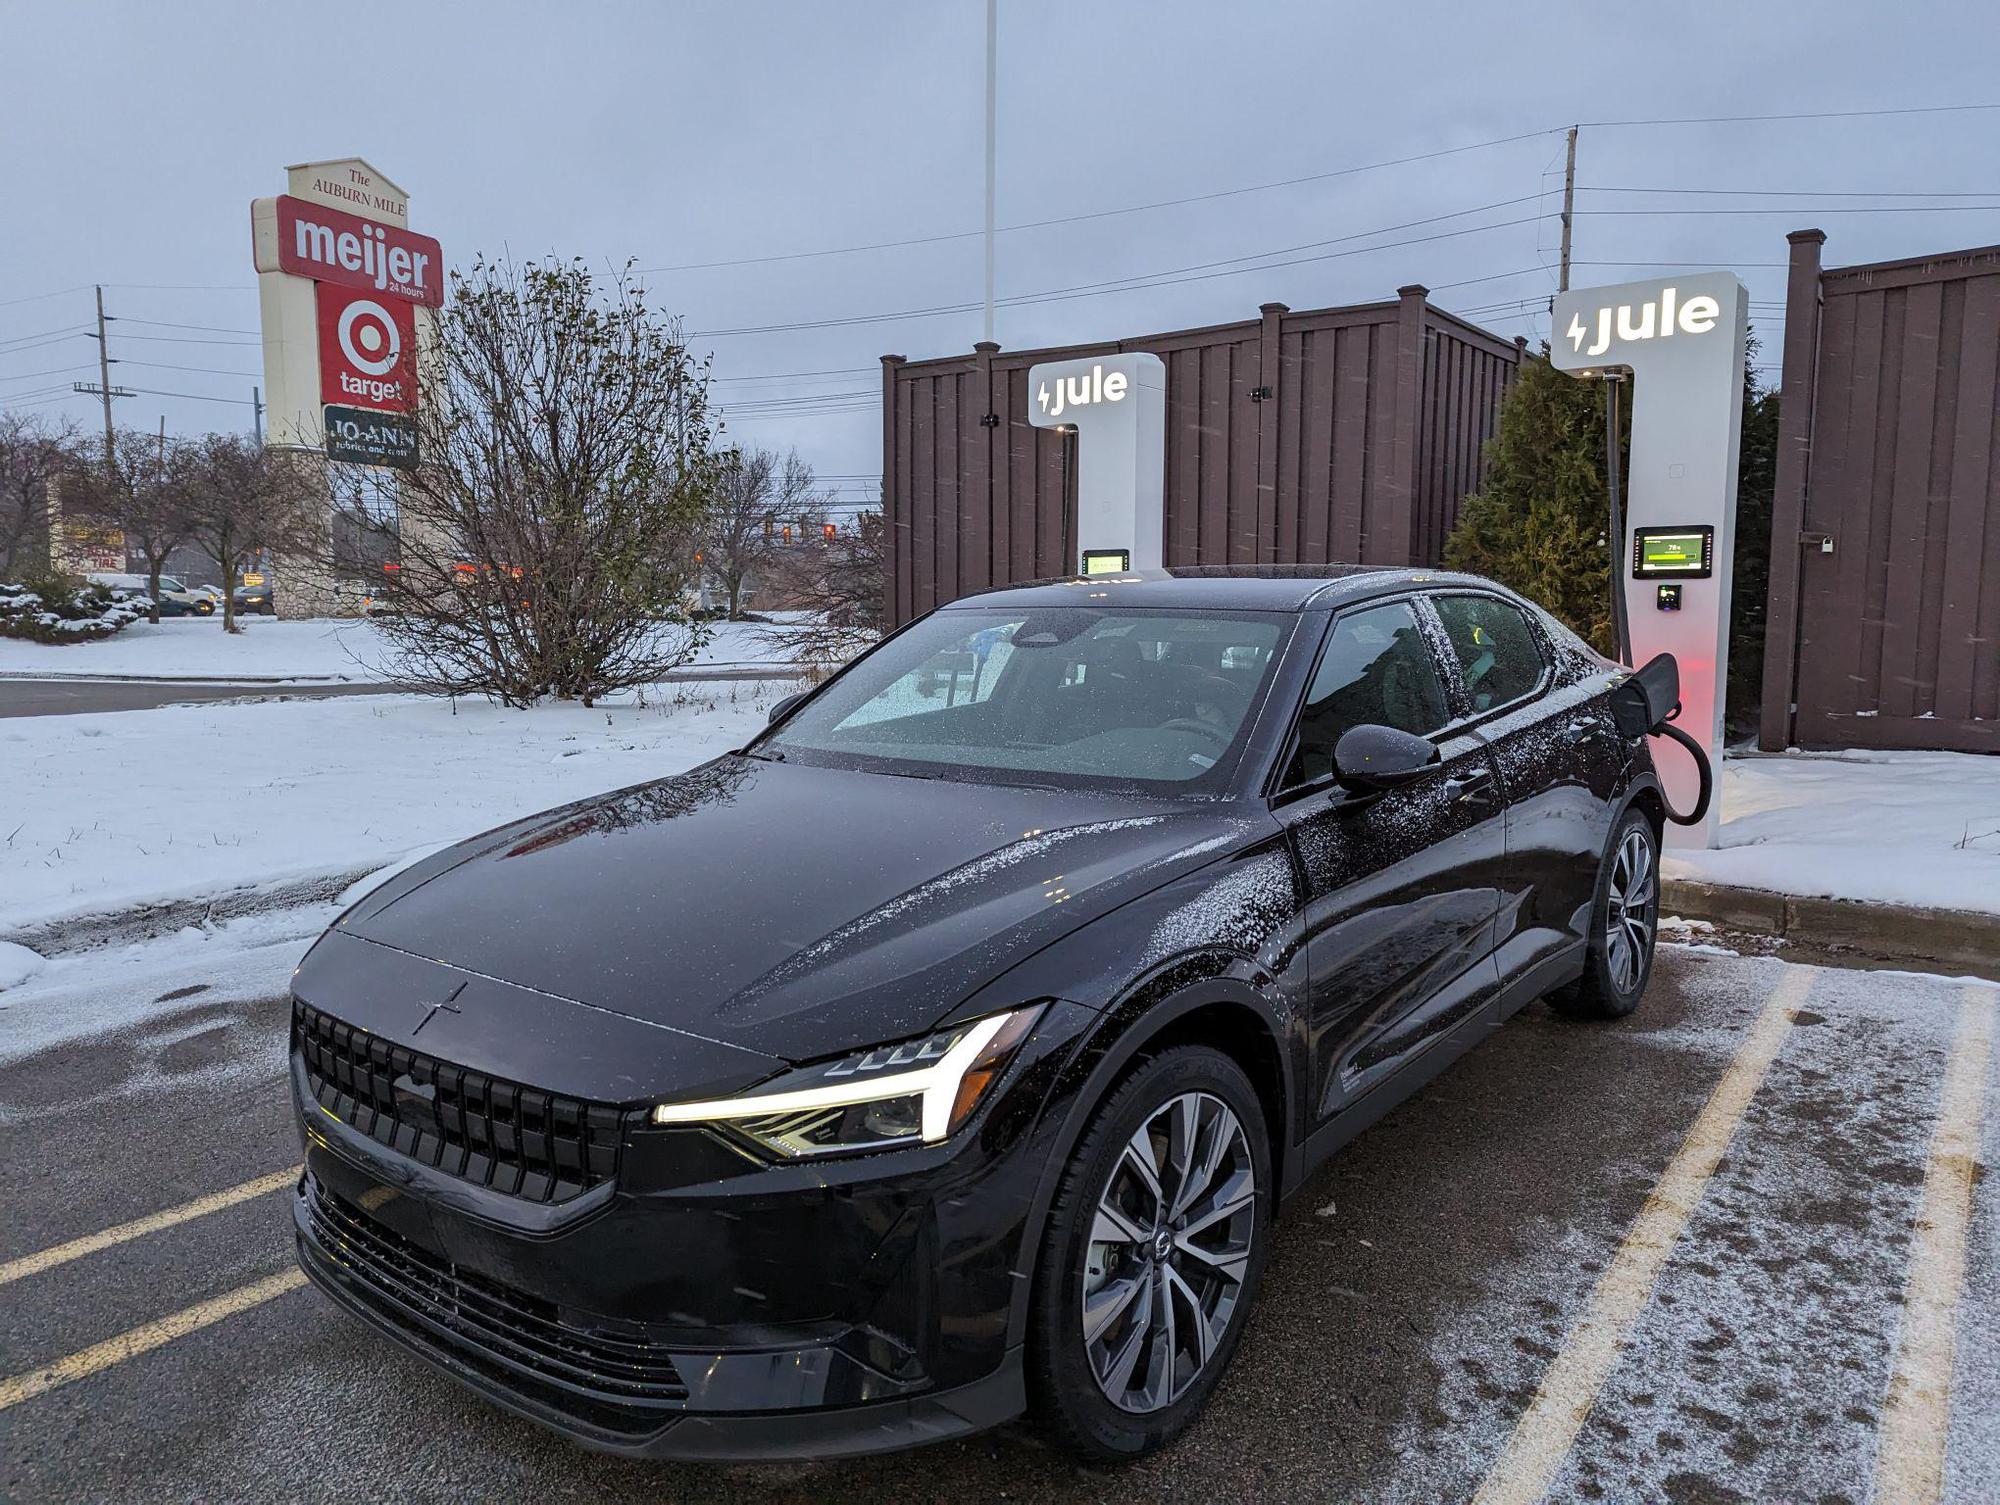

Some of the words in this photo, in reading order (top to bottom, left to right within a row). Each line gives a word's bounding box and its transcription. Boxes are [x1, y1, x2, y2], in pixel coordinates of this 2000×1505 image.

[313, 178, 371, 207] AUBURN
[373, 197, 405, 217] MILE
[349, 169, 370, 187] The
[295, 219, 429, 290] meijer
[389, 282, 400, 294] 24
[401, 284, 425, 299] hours
[1587, 287, 1720, 356] jule
[1050, 365, 1128, 416] jule
